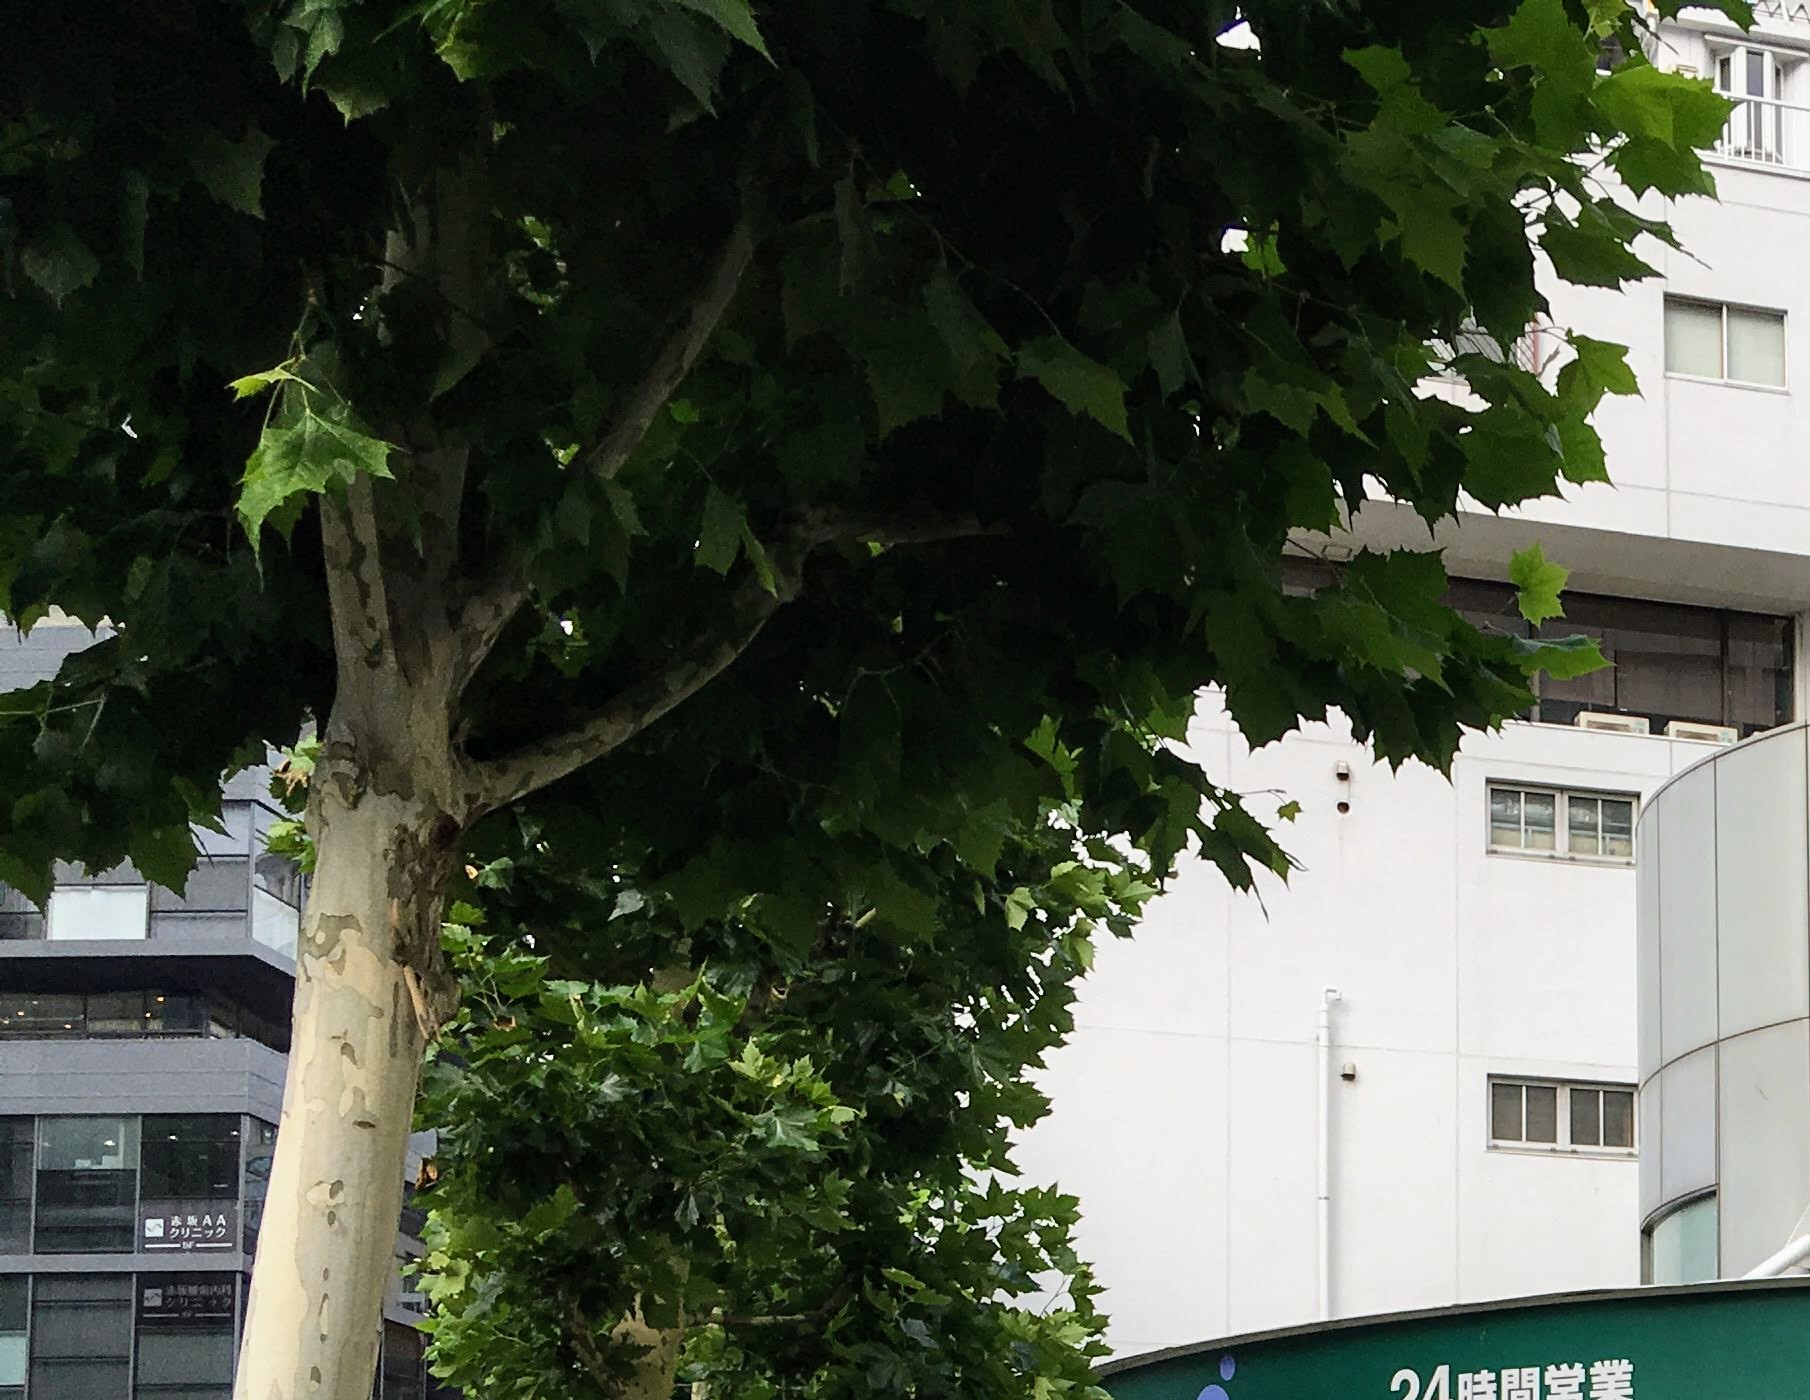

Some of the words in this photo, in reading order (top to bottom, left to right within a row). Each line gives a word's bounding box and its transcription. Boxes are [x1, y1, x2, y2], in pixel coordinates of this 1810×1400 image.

[169, 1226, 227, 1239] クリニック
